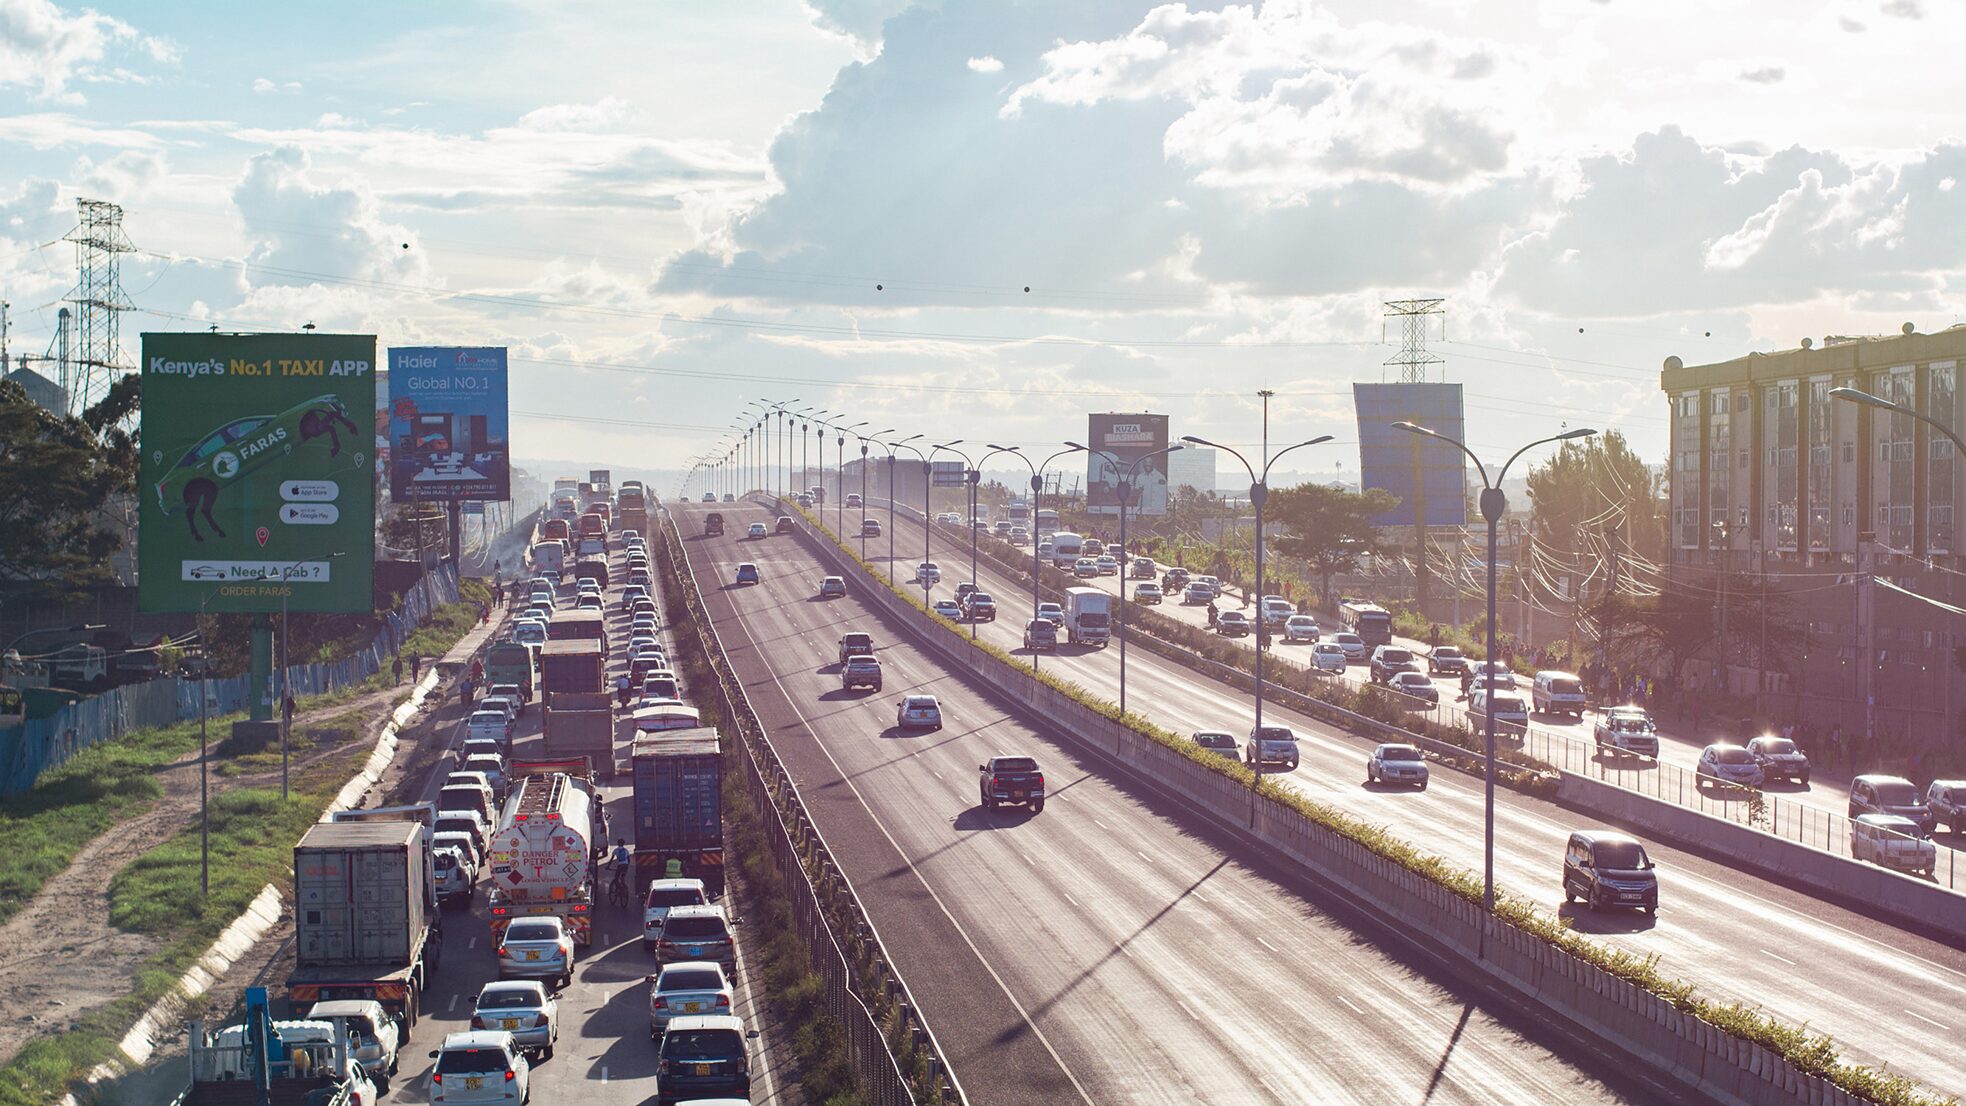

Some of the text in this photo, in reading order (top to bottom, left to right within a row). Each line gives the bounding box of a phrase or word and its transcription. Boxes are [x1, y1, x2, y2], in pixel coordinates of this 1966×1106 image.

[150, 357, 369, 378] Kenya's No.1 TAXI APP
[398, 355, 438, 369] Haier
[408, 377, 450, 389] Global
[1115, 425, 1139, 433] KUZA
[240, 427, 287, 460] FARAS
[231, 566, 265, 577] Need
[270, 566, 279, 577] A
[220, 586, 291, 597] ORDER FARAS
[523, 858, 559, 866] PETROL
[534, 866, 543, 878] T
